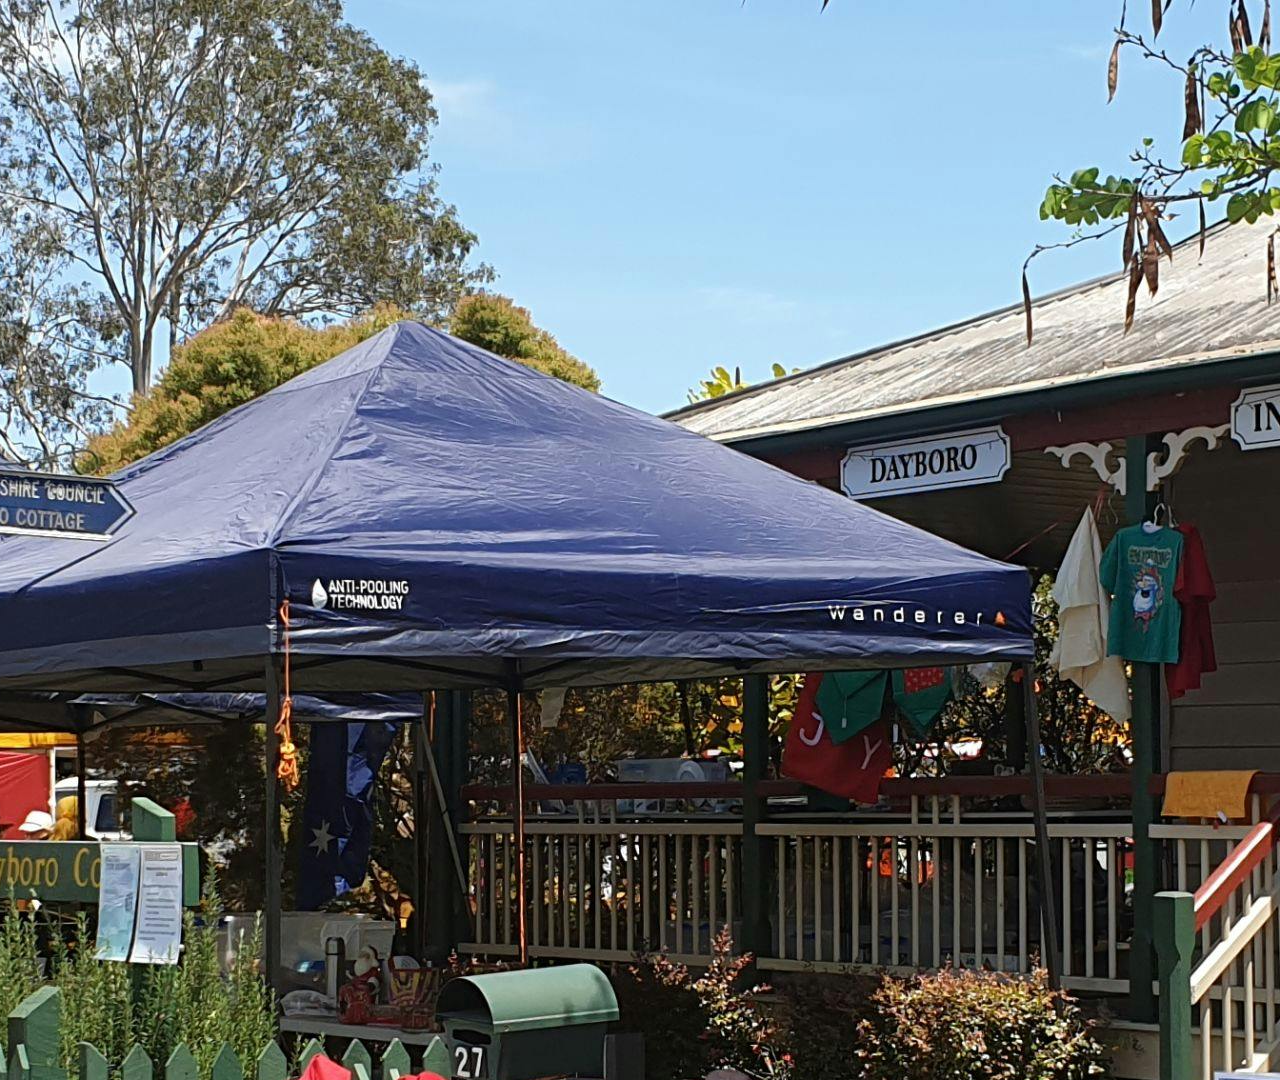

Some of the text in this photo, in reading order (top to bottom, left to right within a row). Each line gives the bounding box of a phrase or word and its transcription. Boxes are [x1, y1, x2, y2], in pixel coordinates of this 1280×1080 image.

[870, 444, 978, 483] DAYBORO
[0, 480, 39, 499] SHIRE
[45, 482, 105, 504] COUNCIL
[16, 508, 85, 531] COTTAGE
[328, 579, 409, 594] ANTI-POOLING
[329, 594, 404, 610] TECHNOLOGY
[454, 1046, 484, 1078] 27
